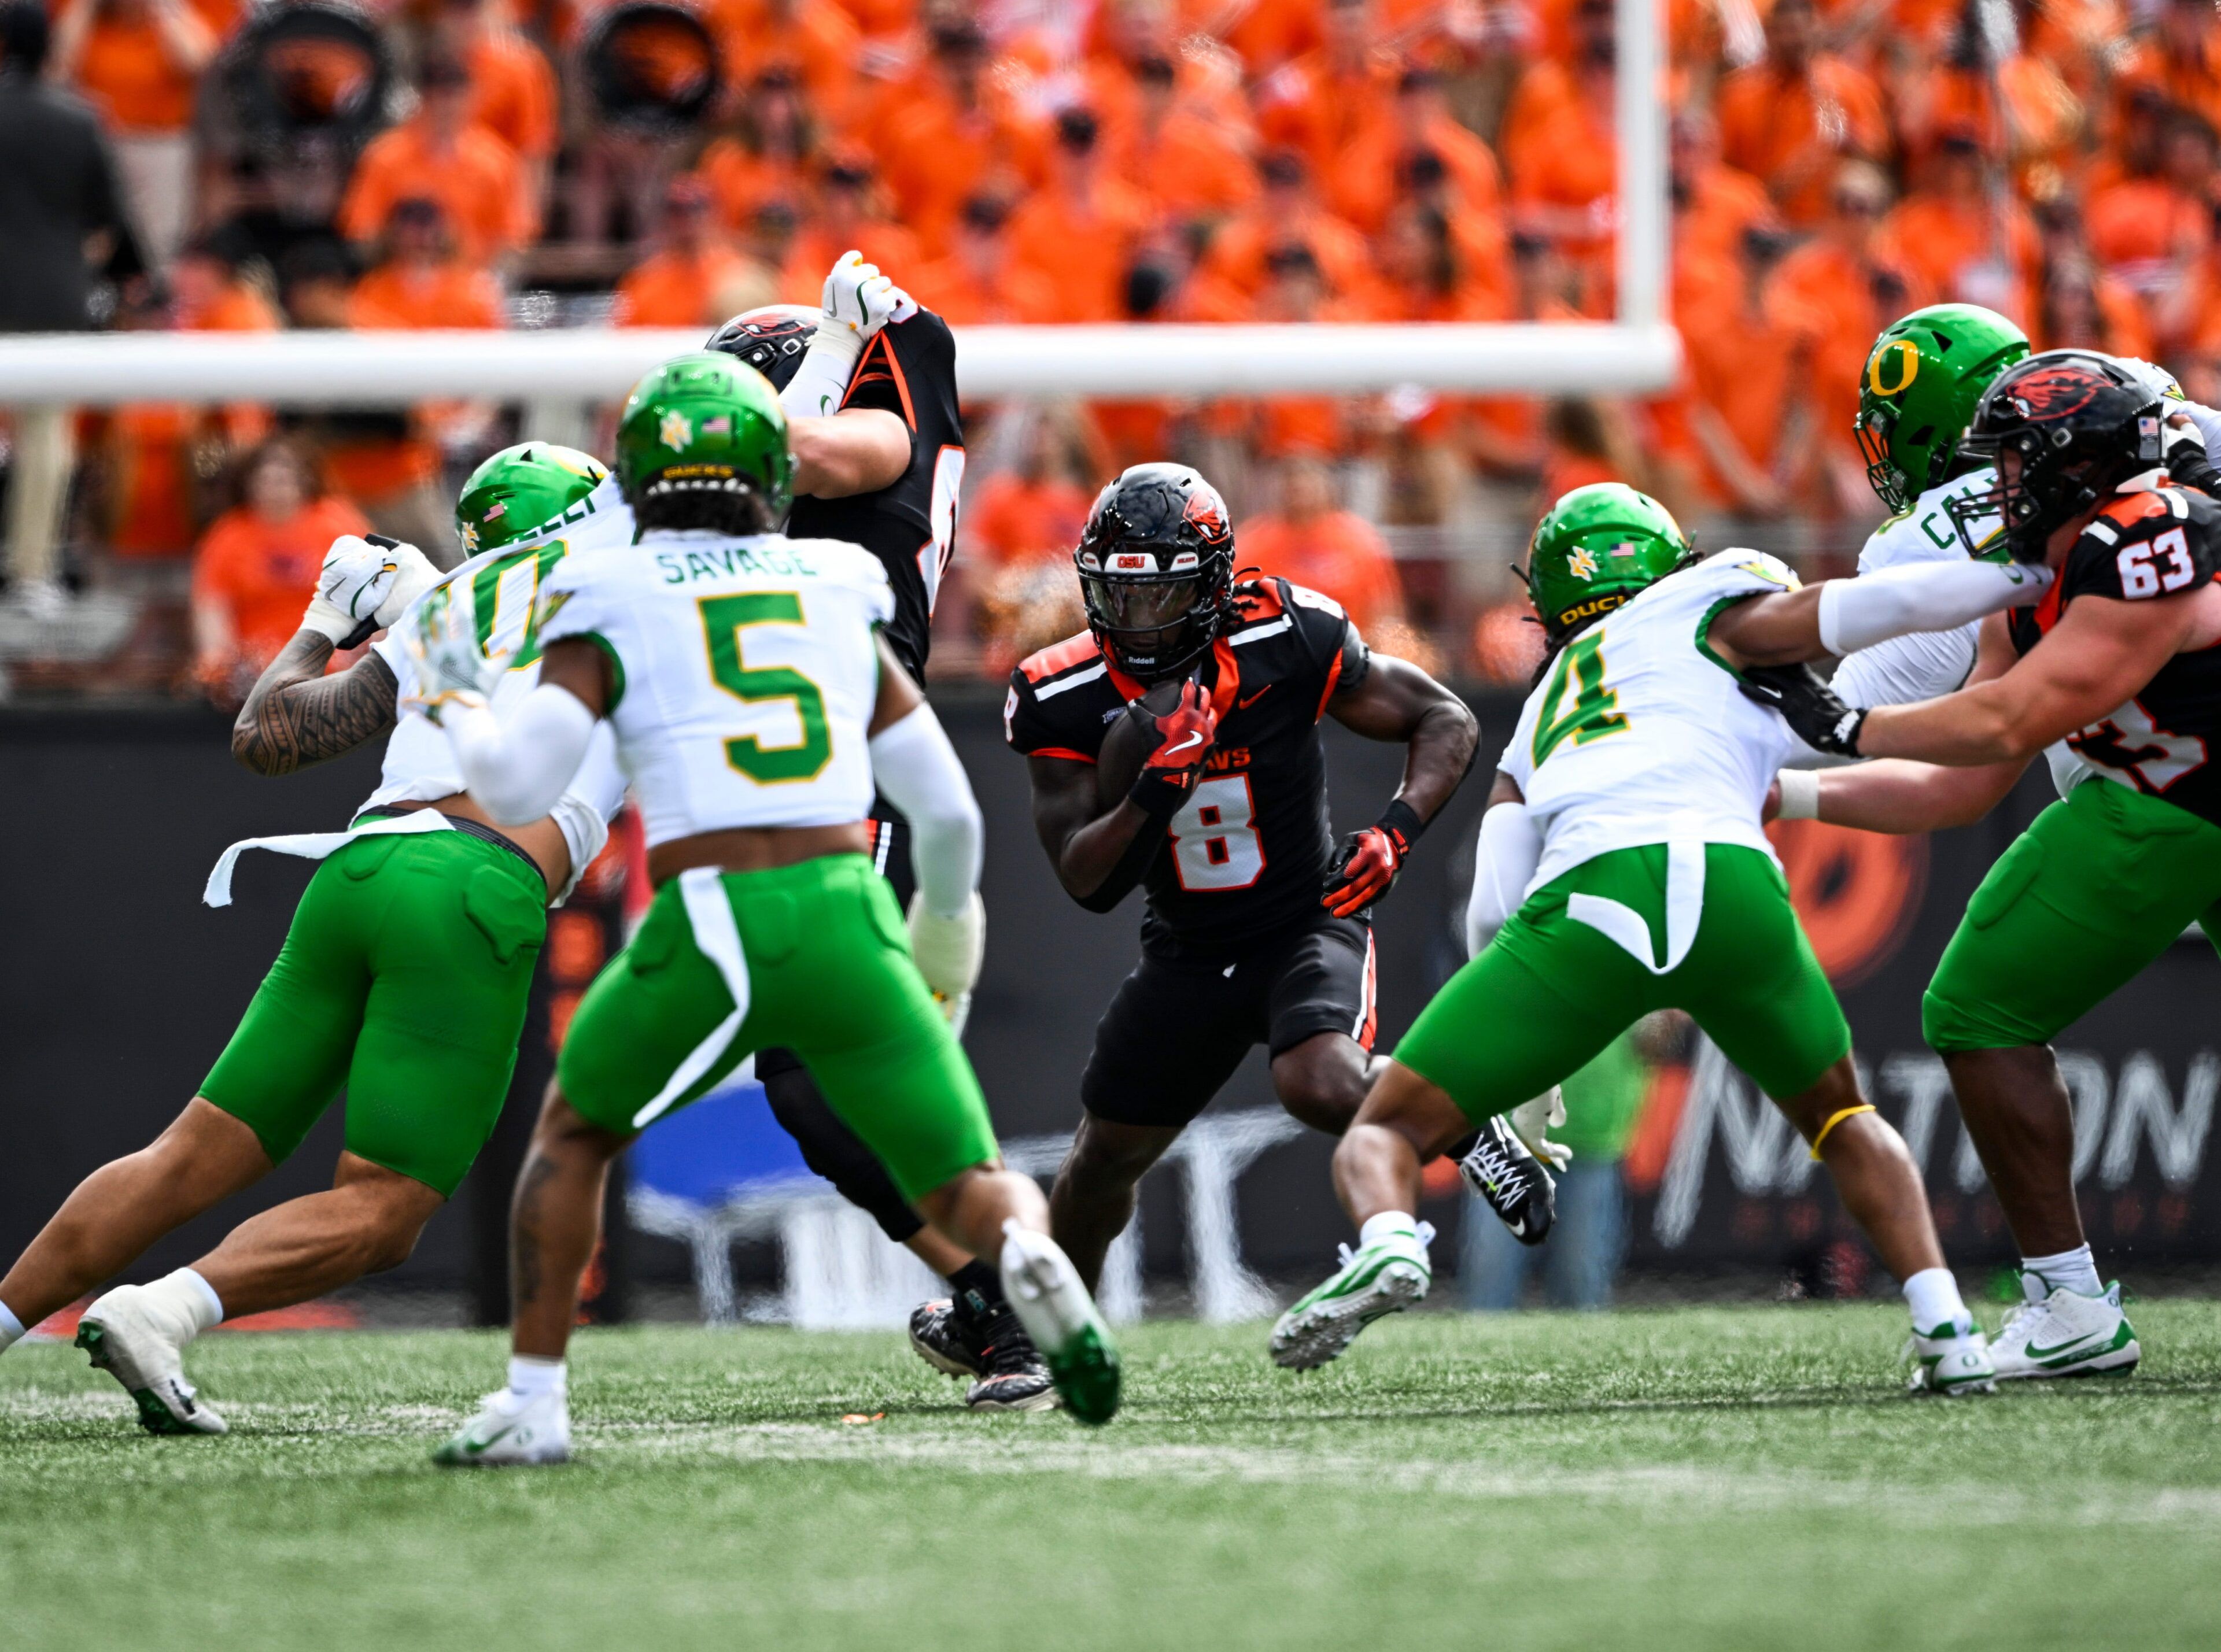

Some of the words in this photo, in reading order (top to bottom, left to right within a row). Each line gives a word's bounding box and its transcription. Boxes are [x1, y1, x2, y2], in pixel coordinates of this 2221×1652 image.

[656, 548, 817, 583] SAVAGE
[1117, 556, 1145, 568] OSU
[2117, 526, 2195, 600] 63
[695, 591, 833, 786] 5
[1128, 656, 1154, 664] Riddell
[1532, 629, 1631, 770] 4
[1168, 771, 1267, 892] 8
